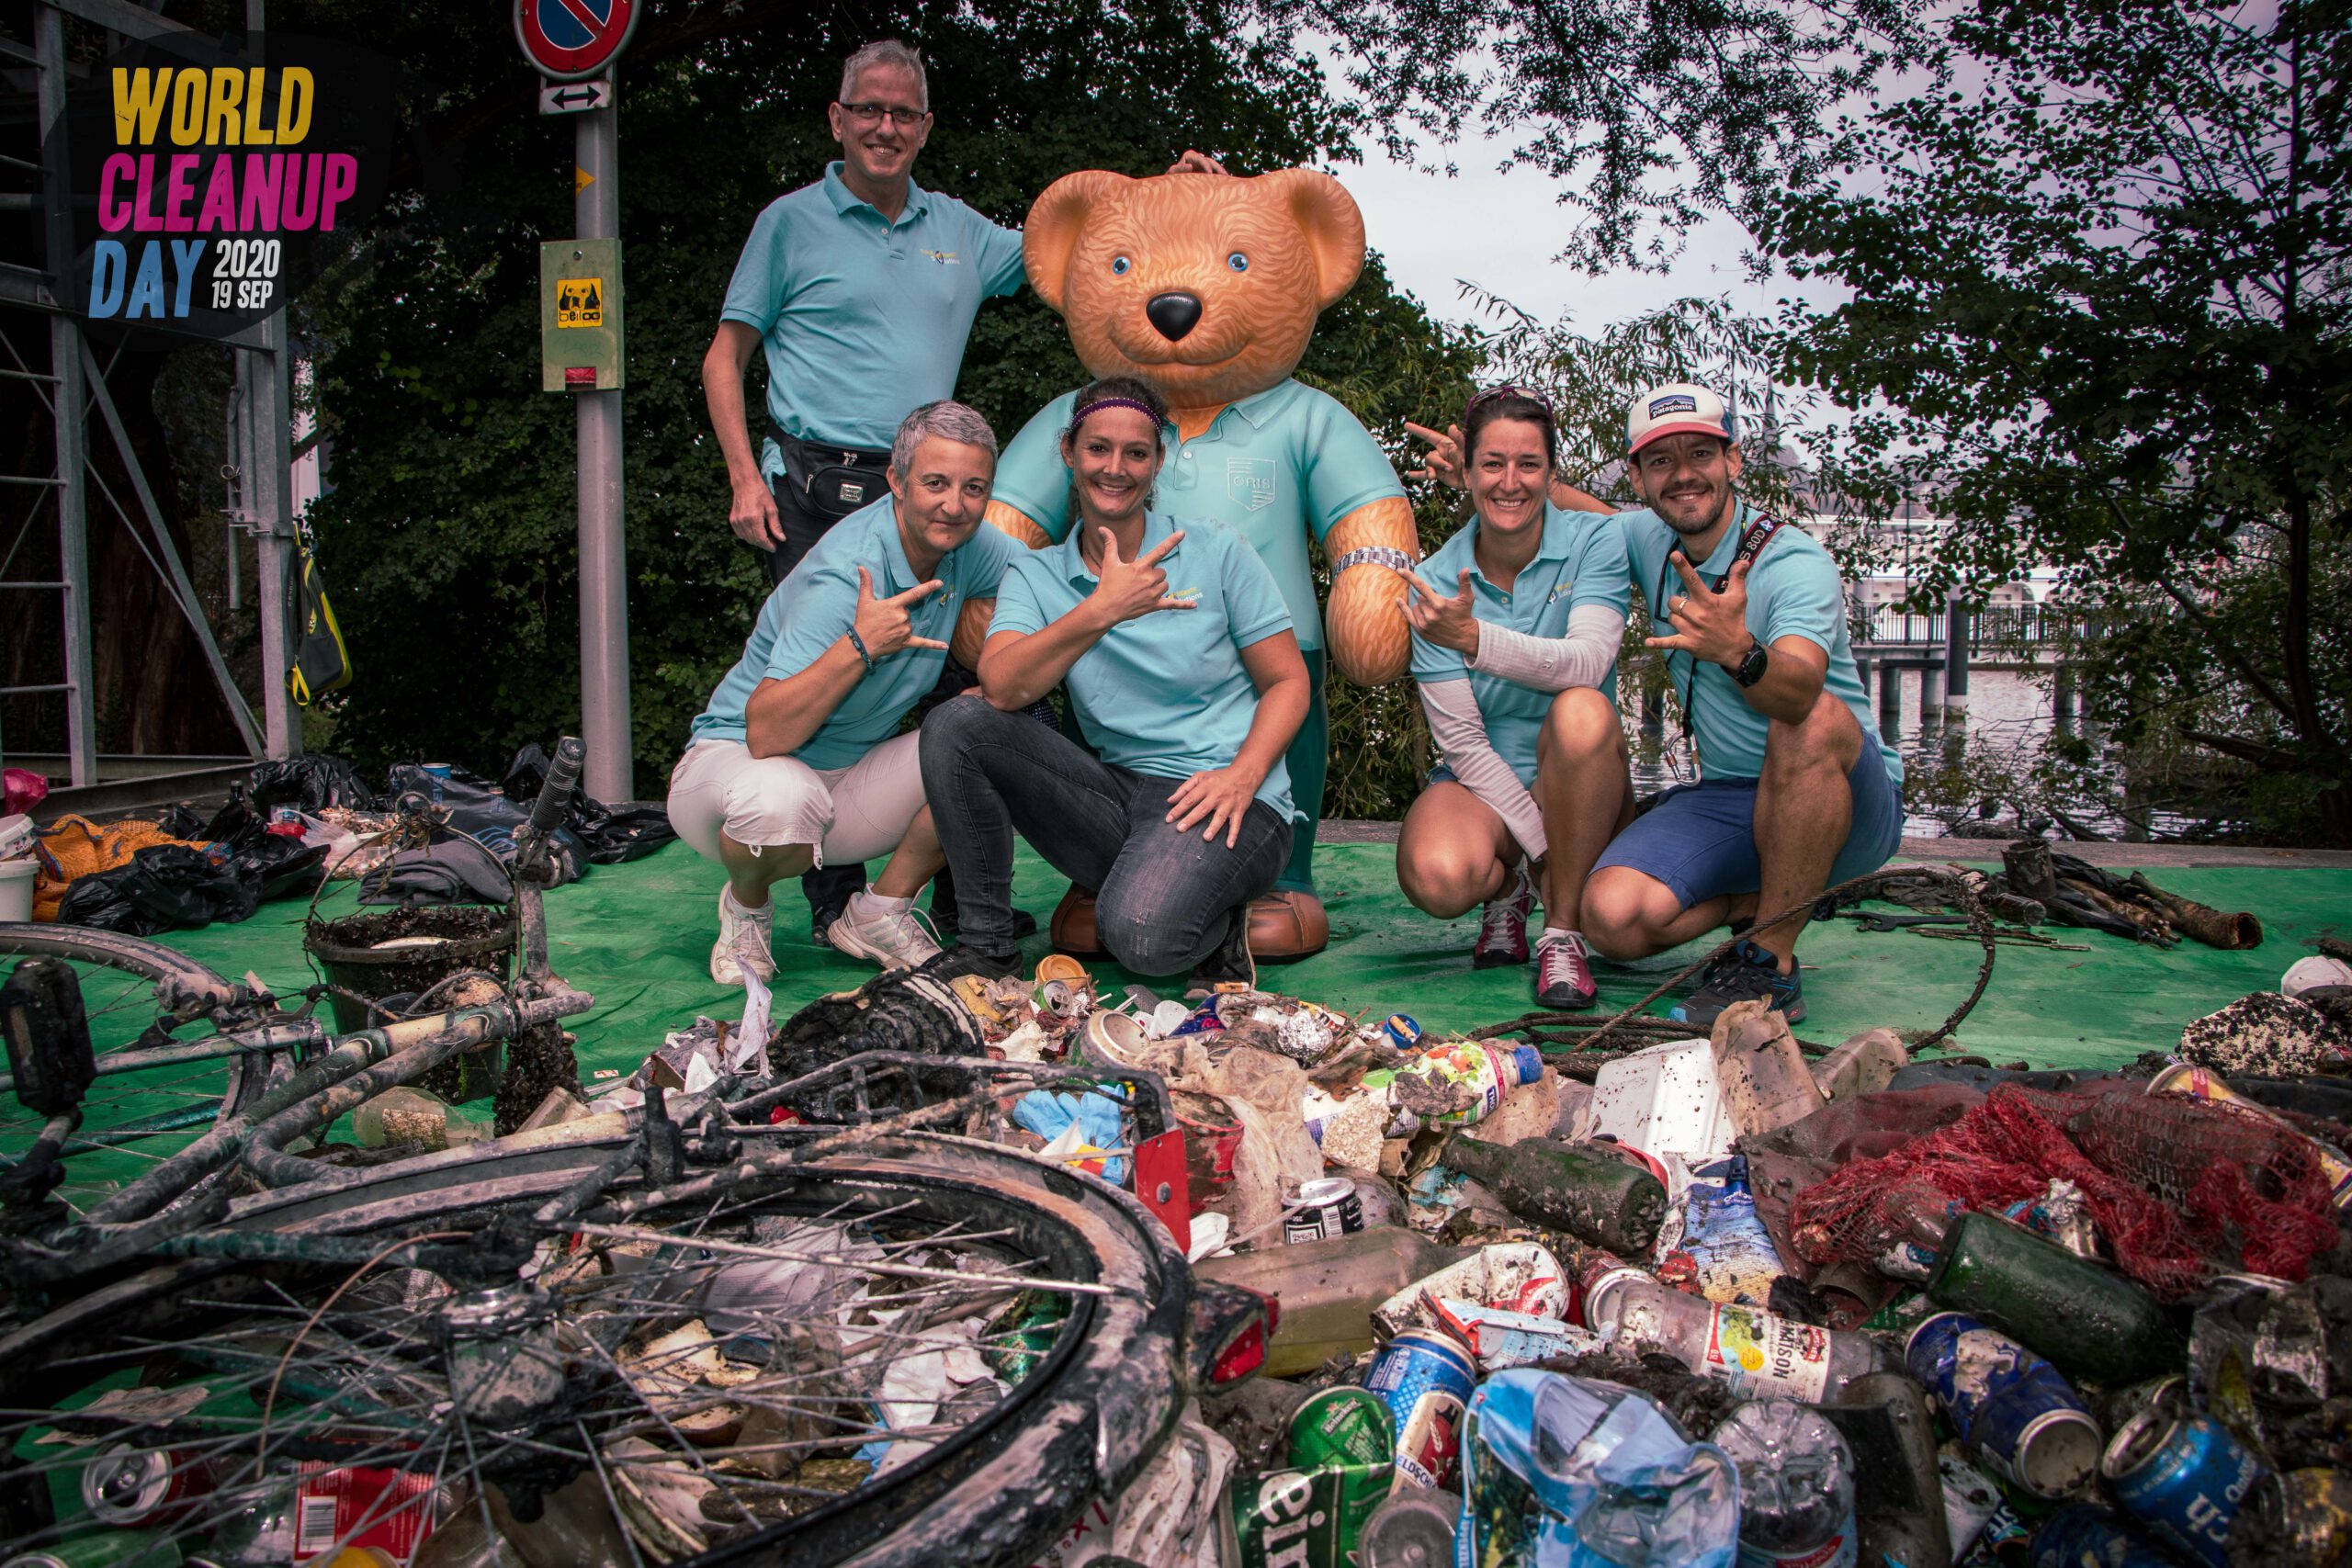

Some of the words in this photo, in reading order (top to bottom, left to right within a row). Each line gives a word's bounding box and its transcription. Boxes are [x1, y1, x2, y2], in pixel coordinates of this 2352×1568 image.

[1652, 403, 1693, 419] patagonia
[1233, 476, 1271, 490] ORIS
[1746, 529, 1766, 550] 80D
